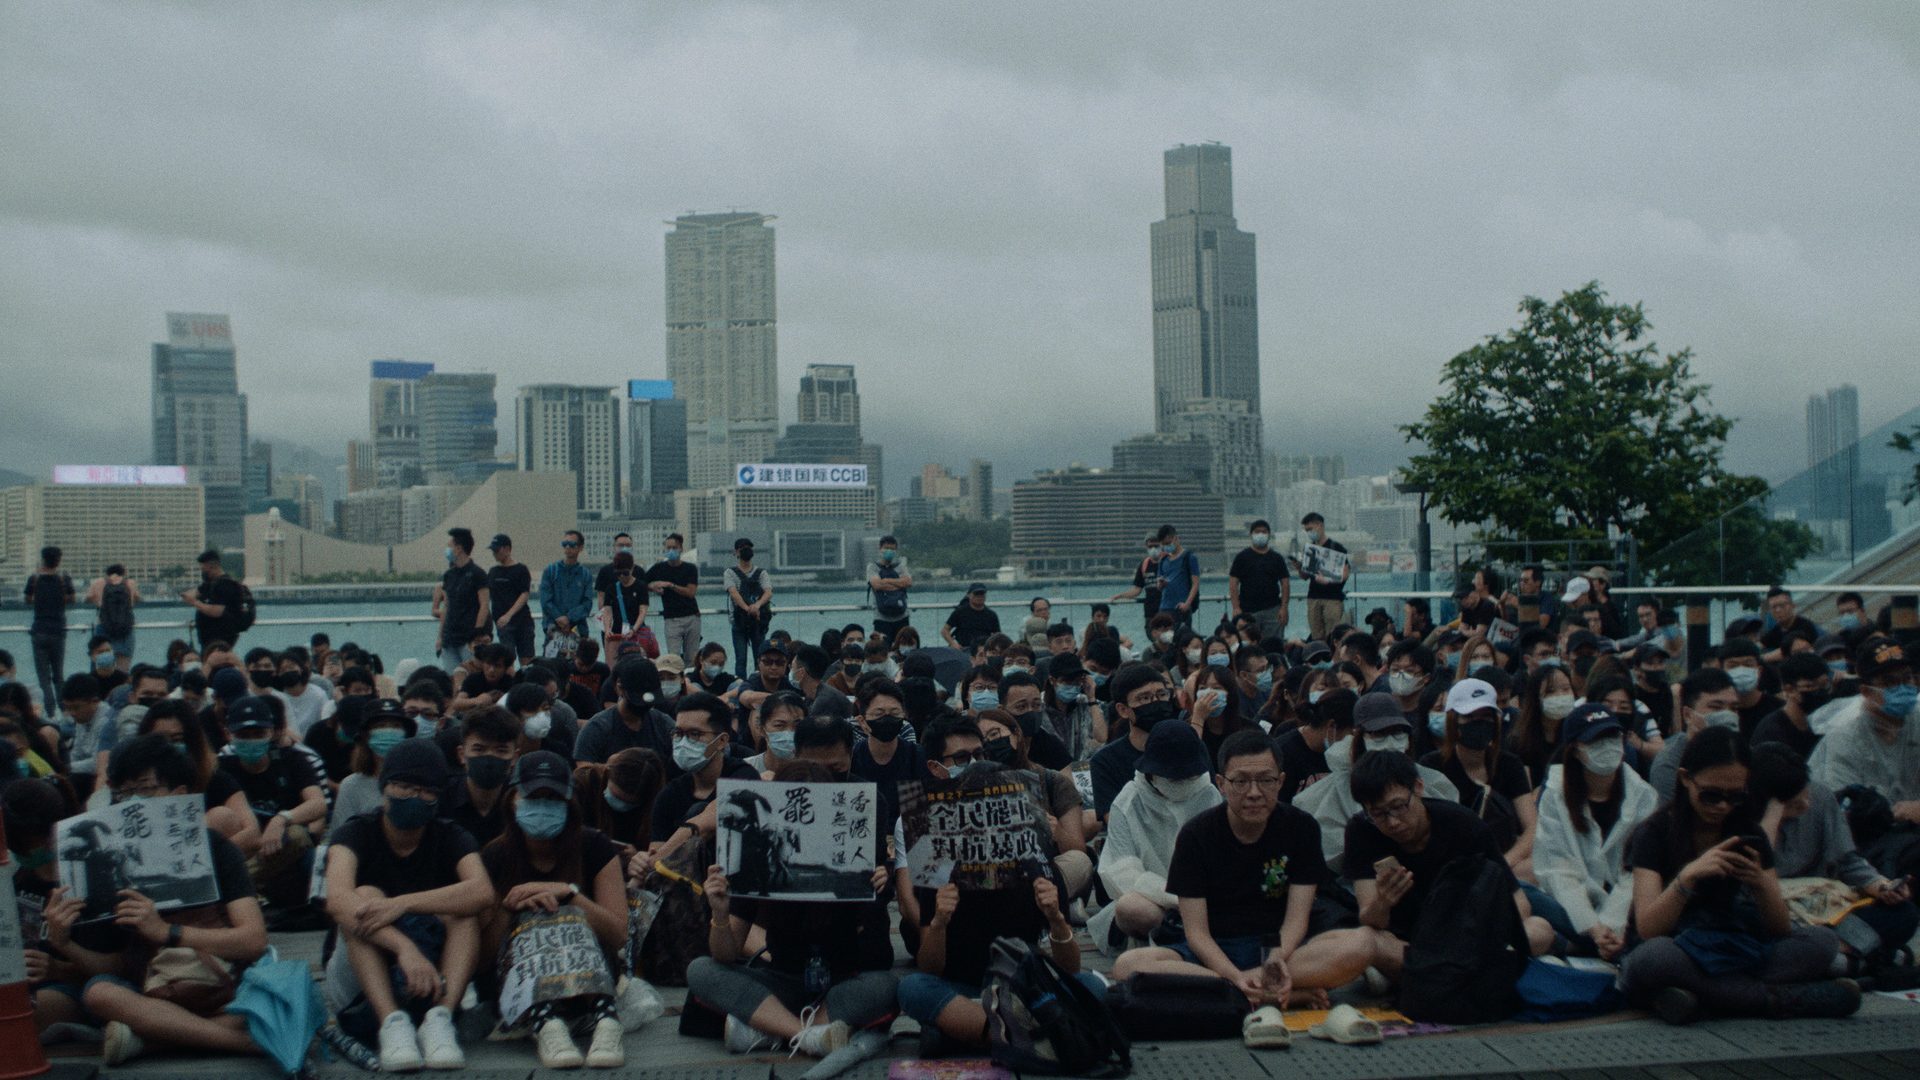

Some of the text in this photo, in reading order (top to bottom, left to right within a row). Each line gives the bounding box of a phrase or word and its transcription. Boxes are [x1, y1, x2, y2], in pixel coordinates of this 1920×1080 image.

[831, 468, 866, 482] CCBI
[779, 786, 815, 825] 罷
[849, 790, 874, 867] 香港人
[514, 924, 588, 956] 全民罷
